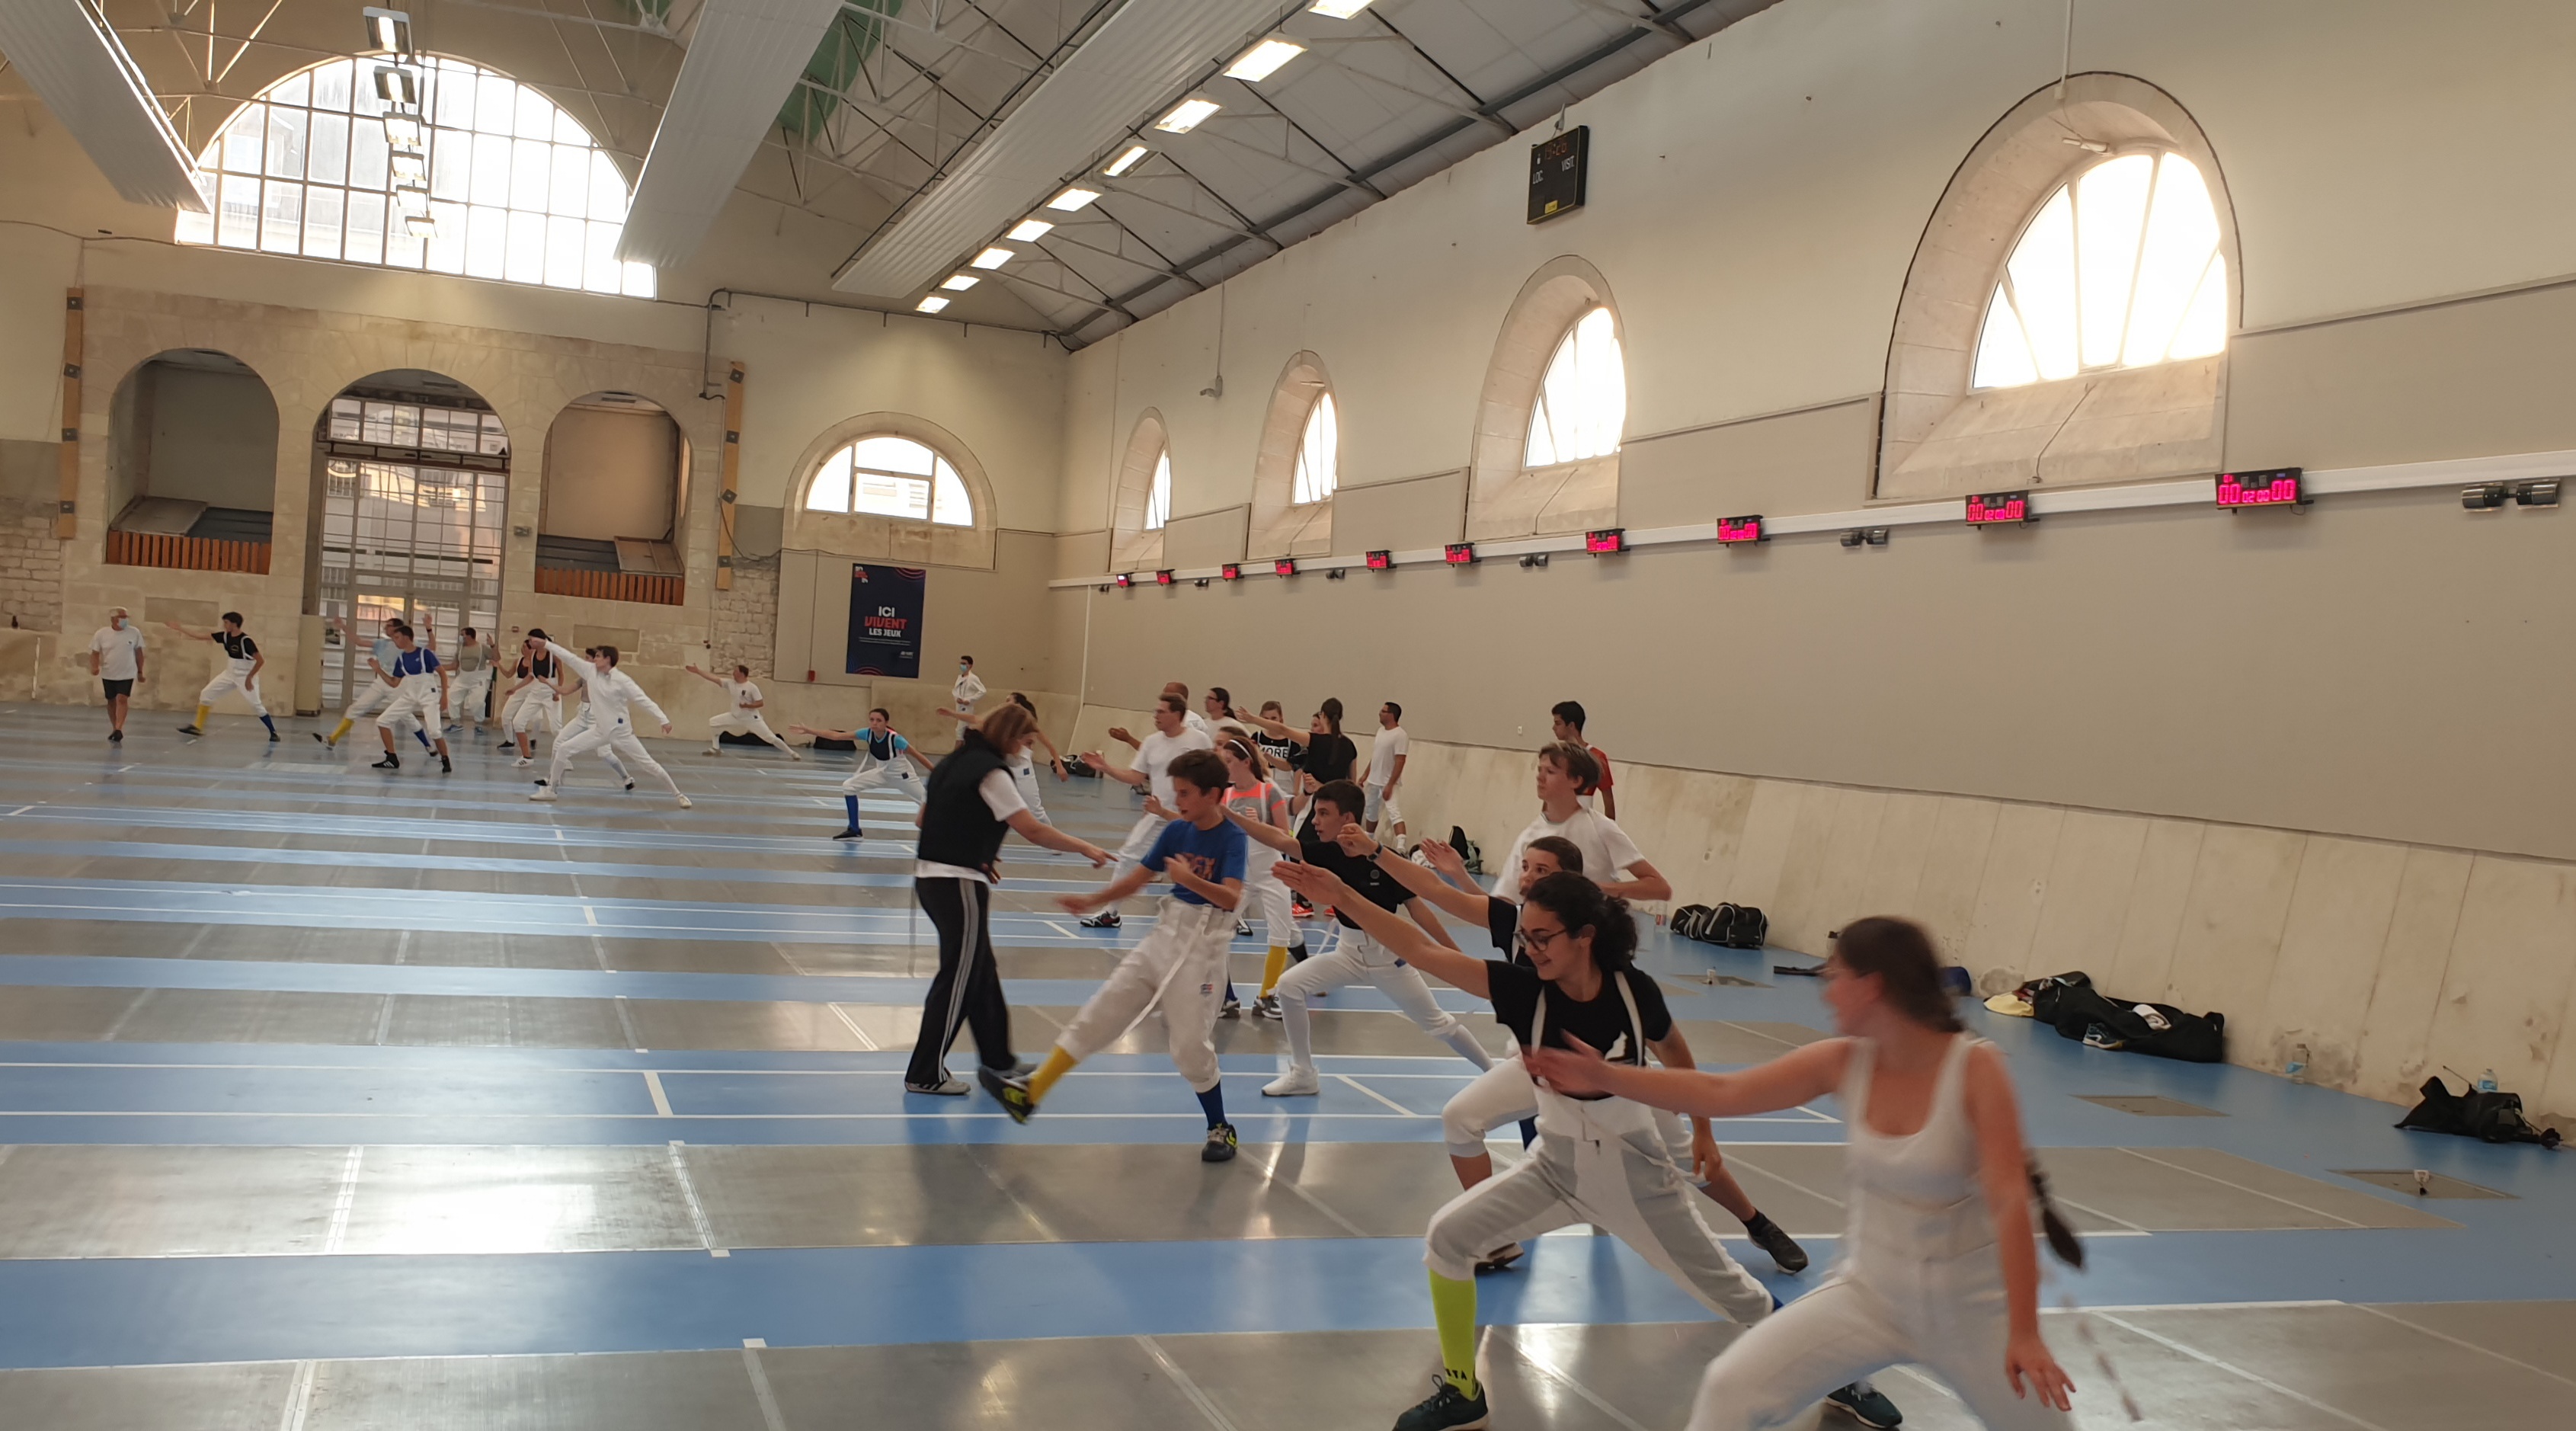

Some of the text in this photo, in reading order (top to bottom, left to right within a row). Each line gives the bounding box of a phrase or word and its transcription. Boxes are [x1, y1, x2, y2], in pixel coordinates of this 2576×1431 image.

[878, 606, 895, 617] ICI
[864, 616, 907, 630] VIVENT
[869, 628, 901, 638] LES JEUX
